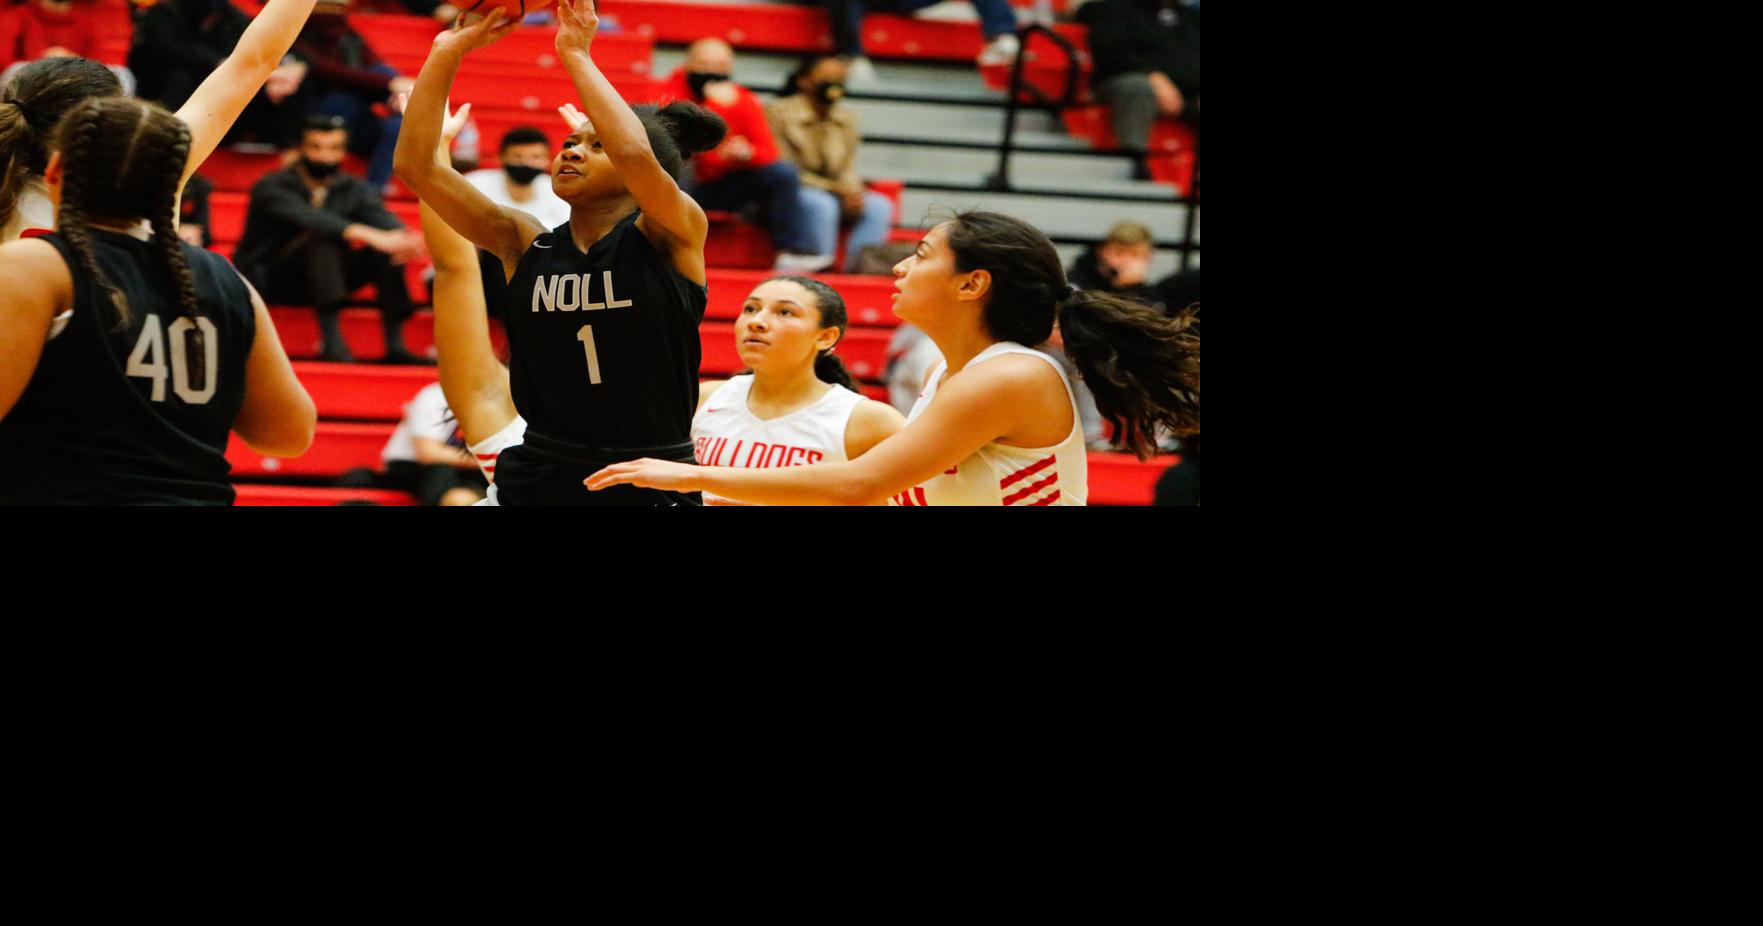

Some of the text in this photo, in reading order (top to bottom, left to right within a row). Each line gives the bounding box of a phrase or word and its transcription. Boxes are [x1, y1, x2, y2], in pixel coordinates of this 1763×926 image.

[531, 270, 633, 312] NOLL
[126, 313, 218, 405] 40
[576, 324, 602, 385] 1
